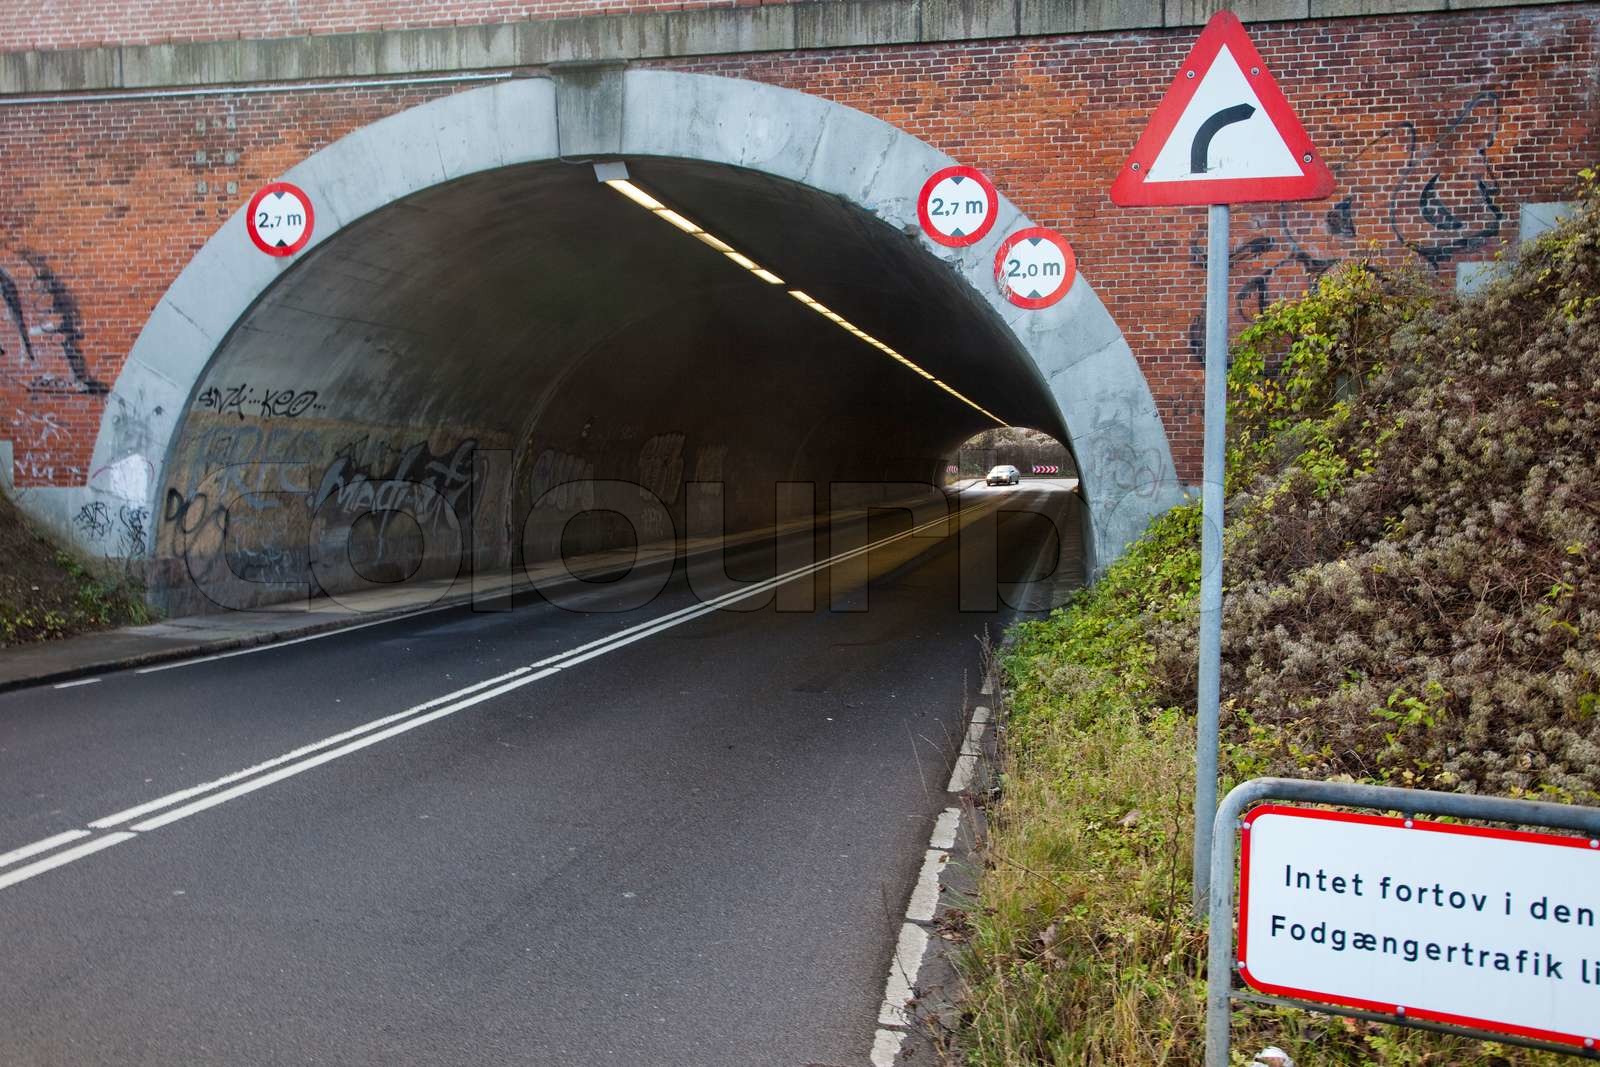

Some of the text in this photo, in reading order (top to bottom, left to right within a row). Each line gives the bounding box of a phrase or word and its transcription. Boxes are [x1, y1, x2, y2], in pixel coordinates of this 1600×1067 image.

[931, 197, 983, 217] 2,7 m
[286, 213, 302, 227] m
[1007, 259, 1061, 279] 2,0 m
[1285, 864, 1595, 927] Intet fortov i den
[1271, 914, 1564, 980] Fodgængertrafik
